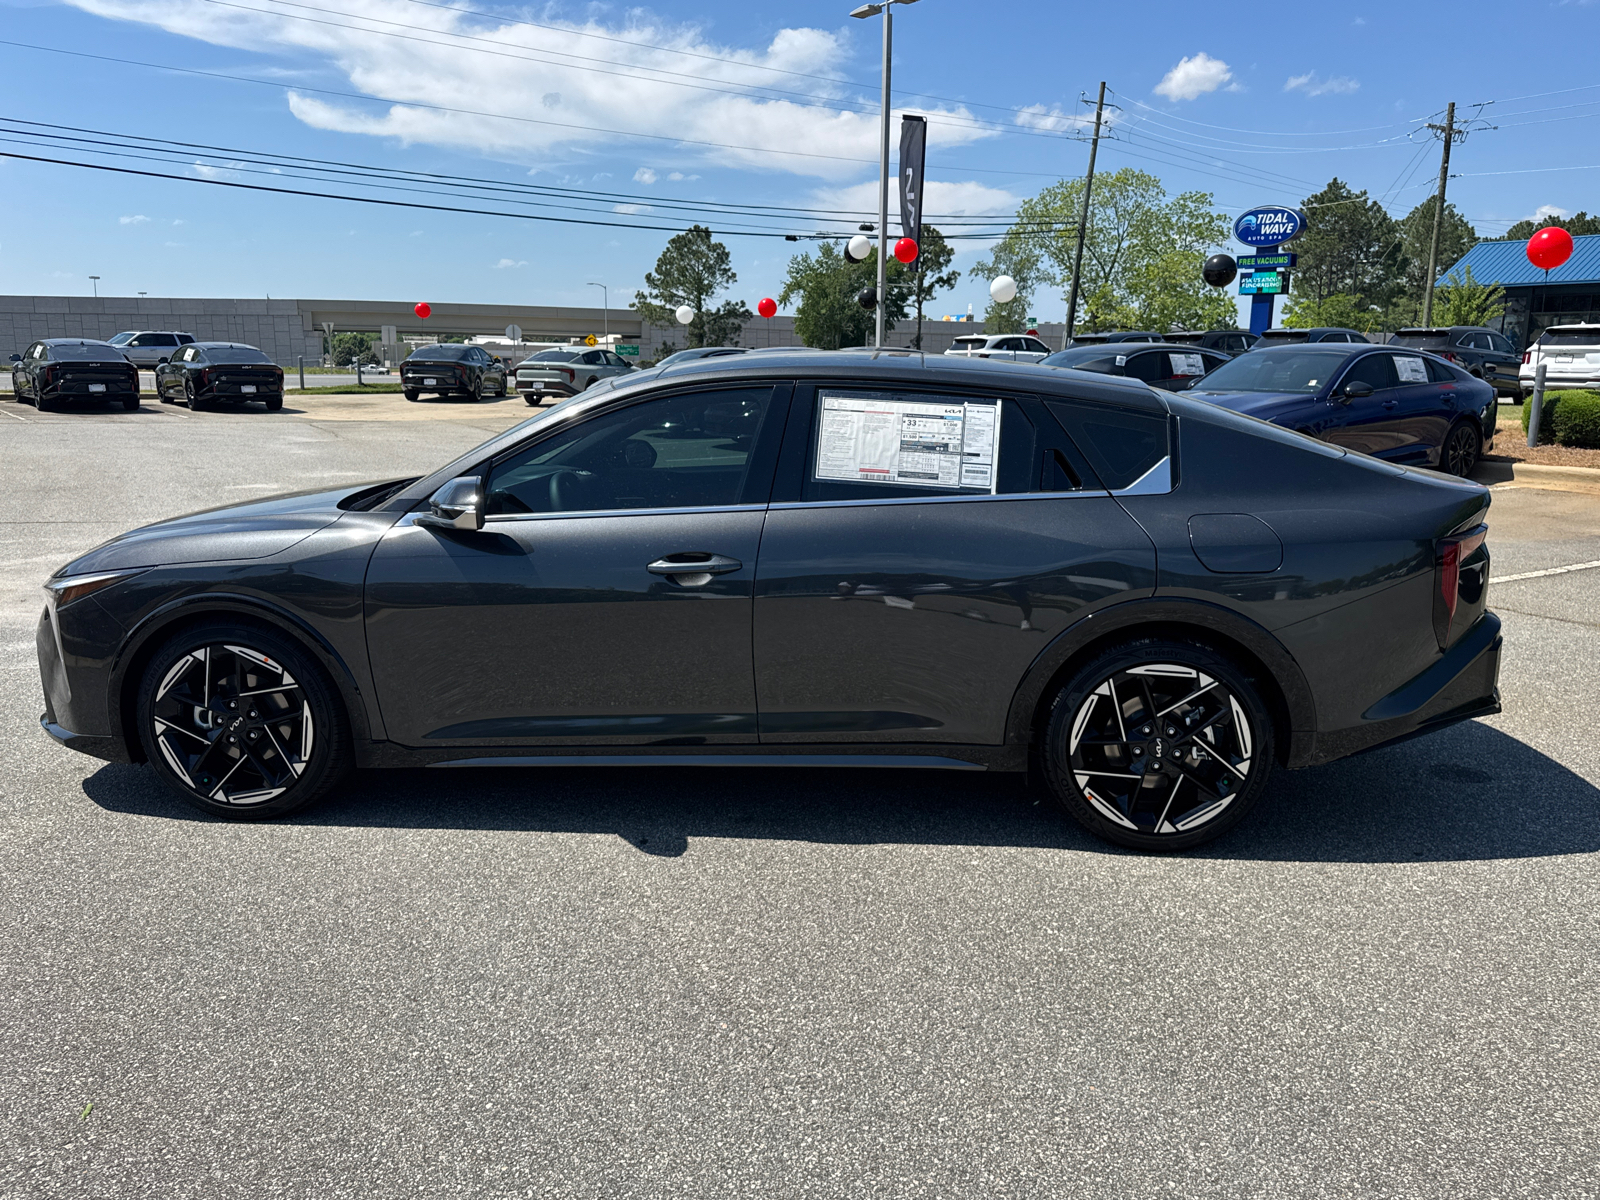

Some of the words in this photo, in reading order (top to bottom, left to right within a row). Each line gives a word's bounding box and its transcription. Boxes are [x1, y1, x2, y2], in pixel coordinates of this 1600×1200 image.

[1256, 212, 1288, 224] TIDAL
[1260, 223, 1294, 234] WAVE
[1257, 256, 1288, 264] VACUUMS
[906, 419, 917, 427] 33
[144, 652, 170, 697] KUMHO
[1060, 778, 1097, 824] KUMHO
